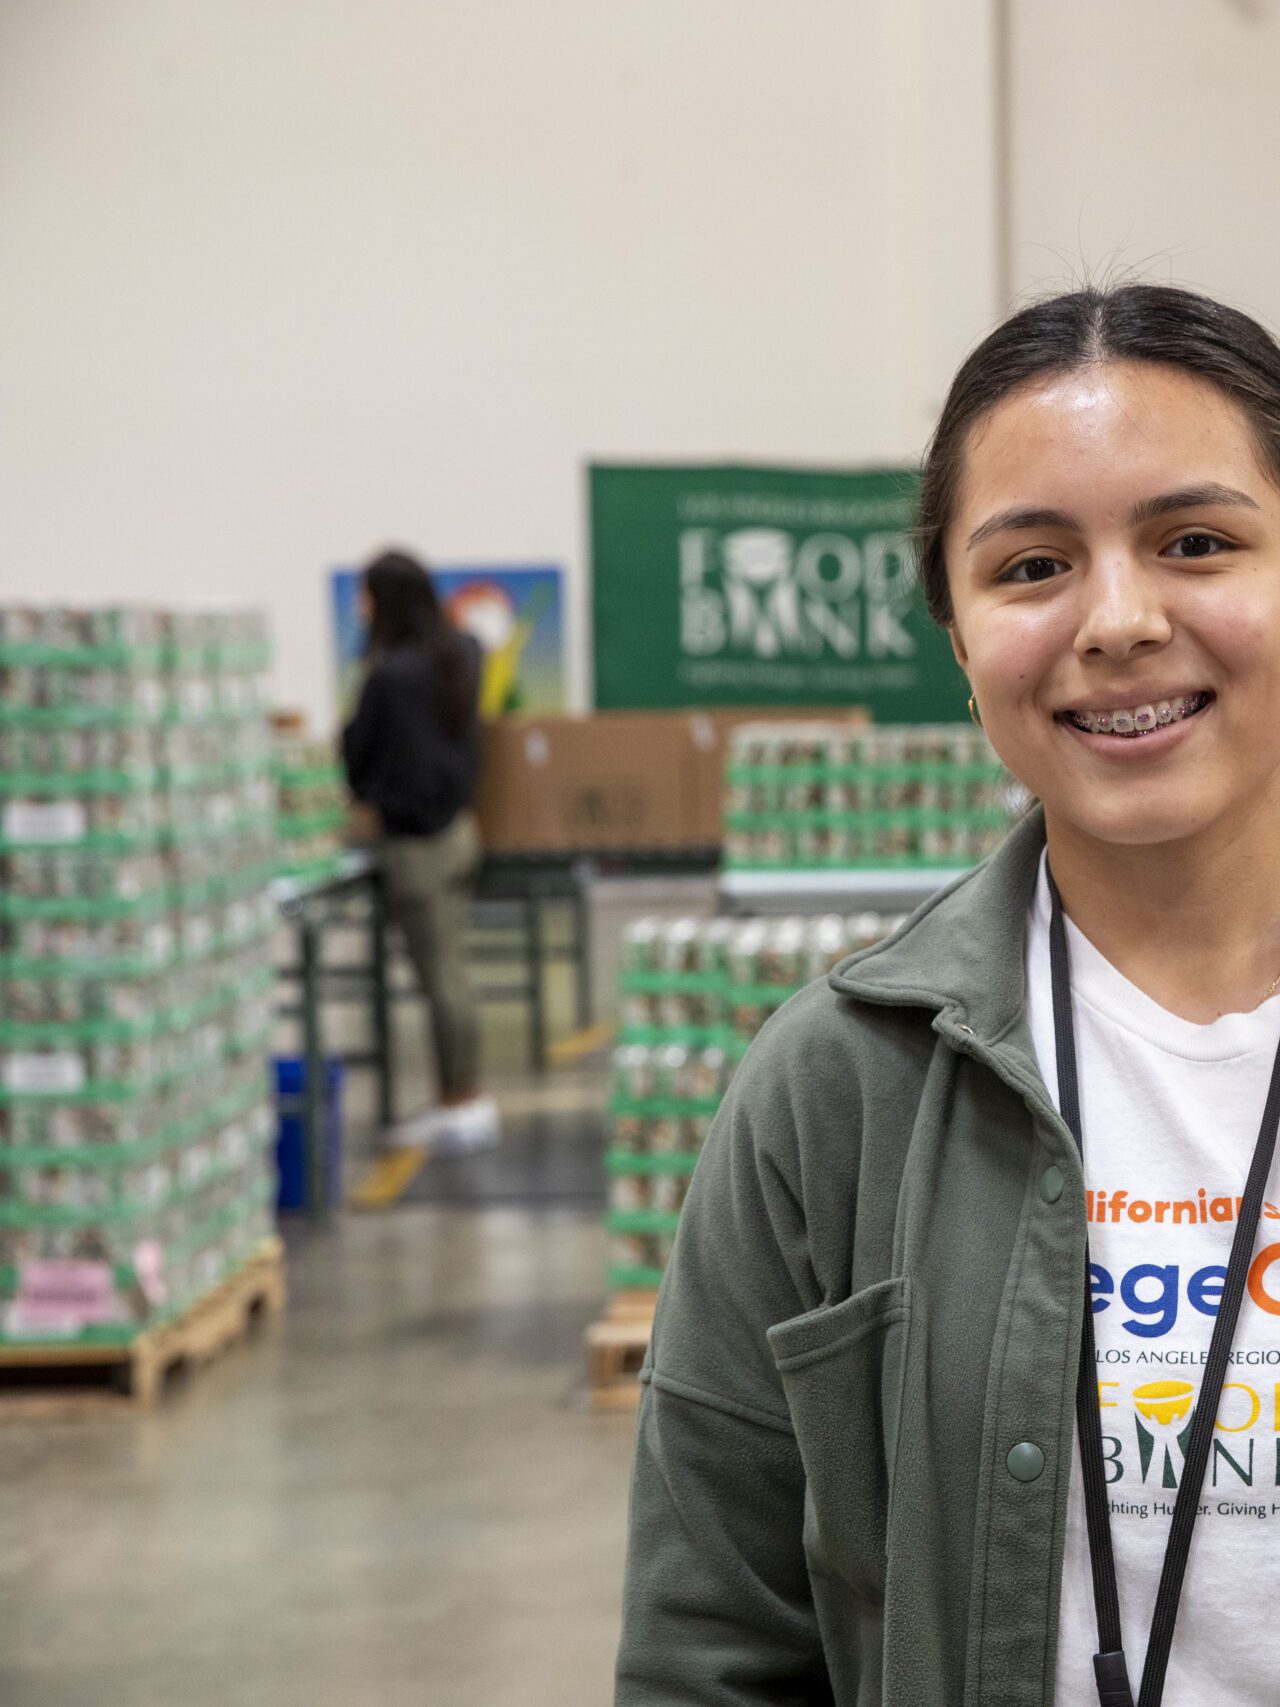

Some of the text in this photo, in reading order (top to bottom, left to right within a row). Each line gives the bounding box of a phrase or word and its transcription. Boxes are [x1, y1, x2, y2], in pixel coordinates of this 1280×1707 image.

[1096, 1349, 1131, 1364] LOS
[1136, 1350, 1208, 1365] ANGELE
[1108, 1500, 1148, 1519] hting
[1154, 1502, 1211, 1516] Huer.
[1217, 1502, 1267, 1519] Giving
